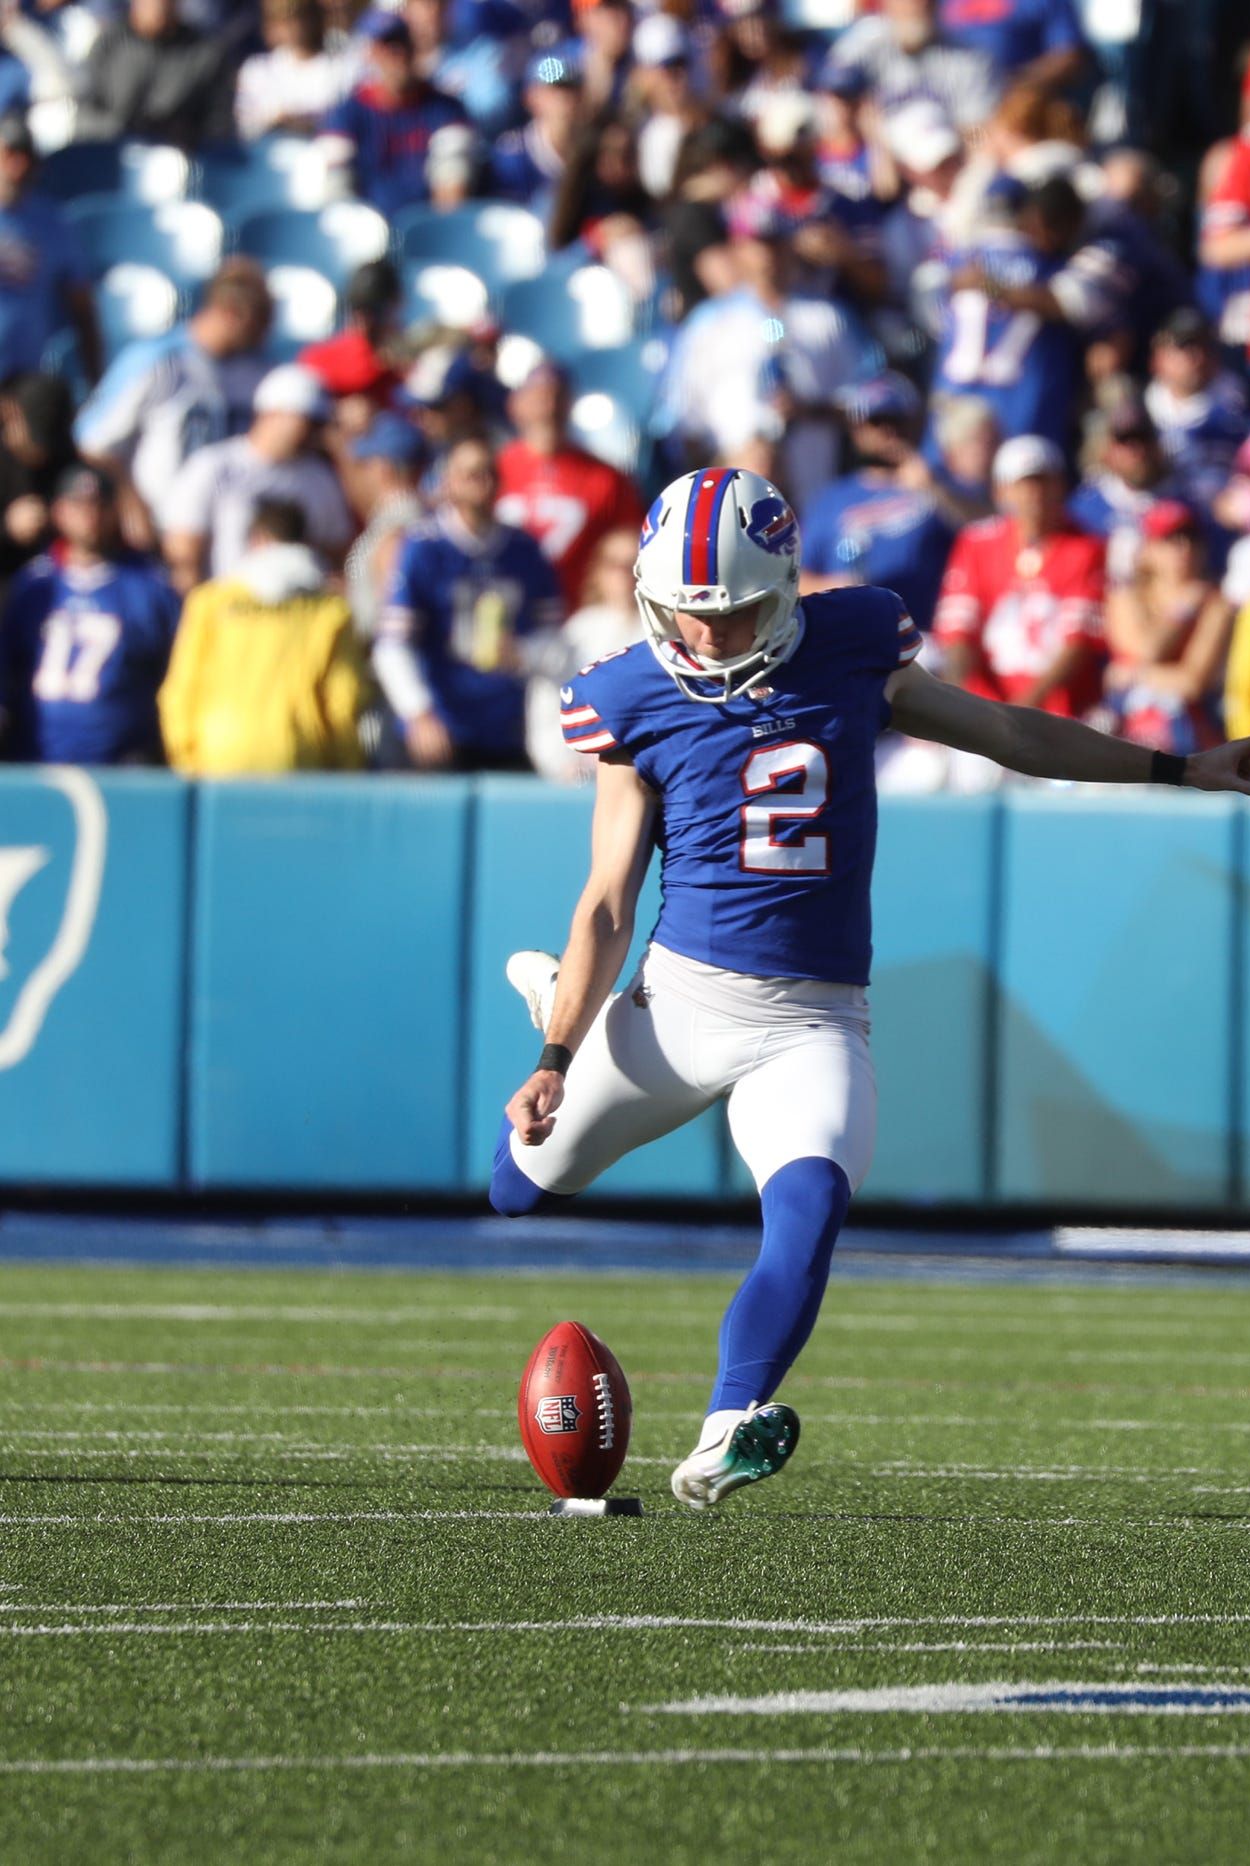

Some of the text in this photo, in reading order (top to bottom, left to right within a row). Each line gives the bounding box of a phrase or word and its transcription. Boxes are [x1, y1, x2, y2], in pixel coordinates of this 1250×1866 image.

[33, 610, 121, 702] 17
[752, 718, 796, 738] BILLS
[739, 738, 832, 876] 2
[543, 1401, 561, 1430] NFL
